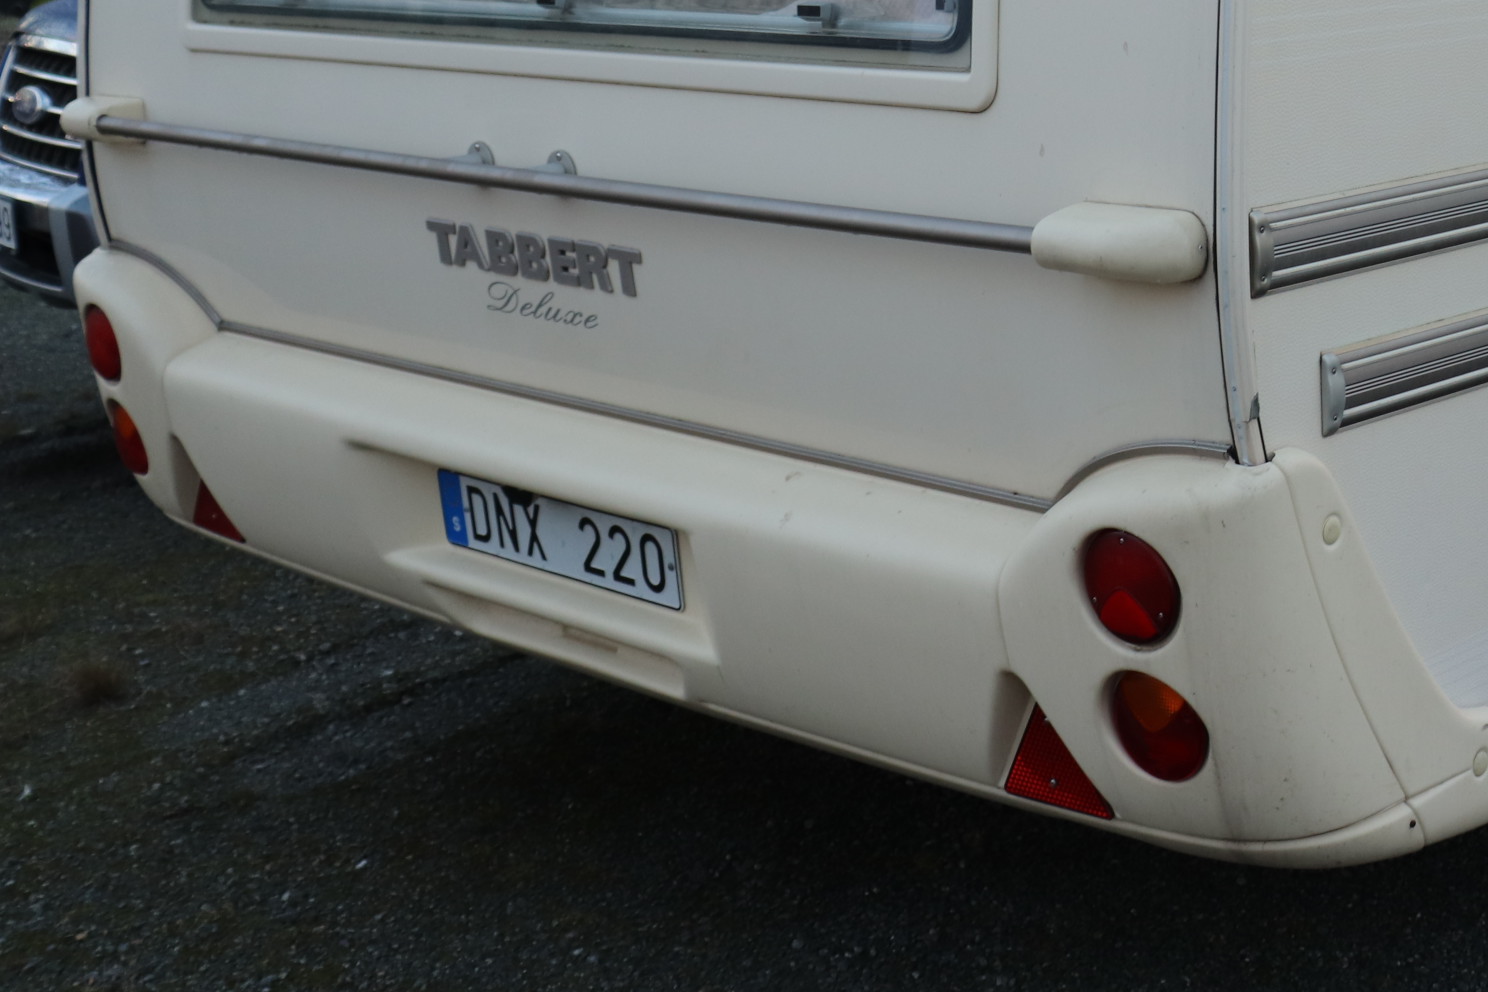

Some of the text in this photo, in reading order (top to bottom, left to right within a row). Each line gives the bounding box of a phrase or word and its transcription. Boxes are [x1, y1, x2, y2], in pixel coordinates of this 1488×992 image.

[425, 217, 642, 298] TABBERT
[486, 280, 600, 330] Deluxe
[452, 516, 461, 532] S
[466, 485, 666, 594] DNX 220
